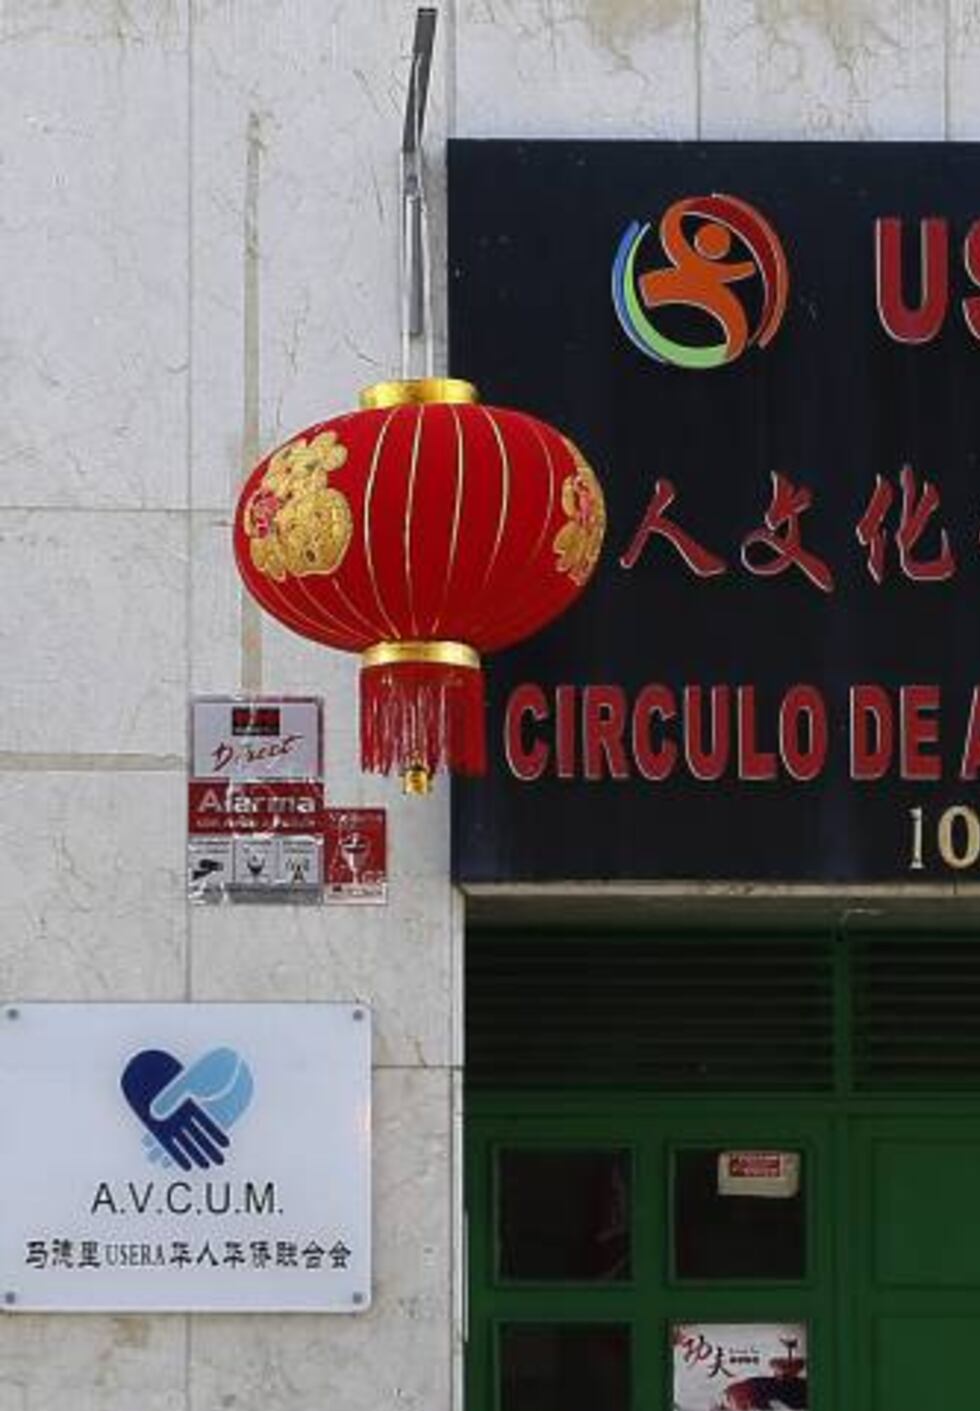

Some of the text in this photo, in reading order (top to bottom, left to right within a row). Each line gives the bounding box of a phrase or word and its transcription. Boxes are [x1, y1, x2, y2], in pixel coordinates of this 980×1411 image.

[504, 684, 829, 782] CIRCULO
[848, 684, 942, 782] DE
[91, 1181, 284, 1215] A.V.C.U.M.
